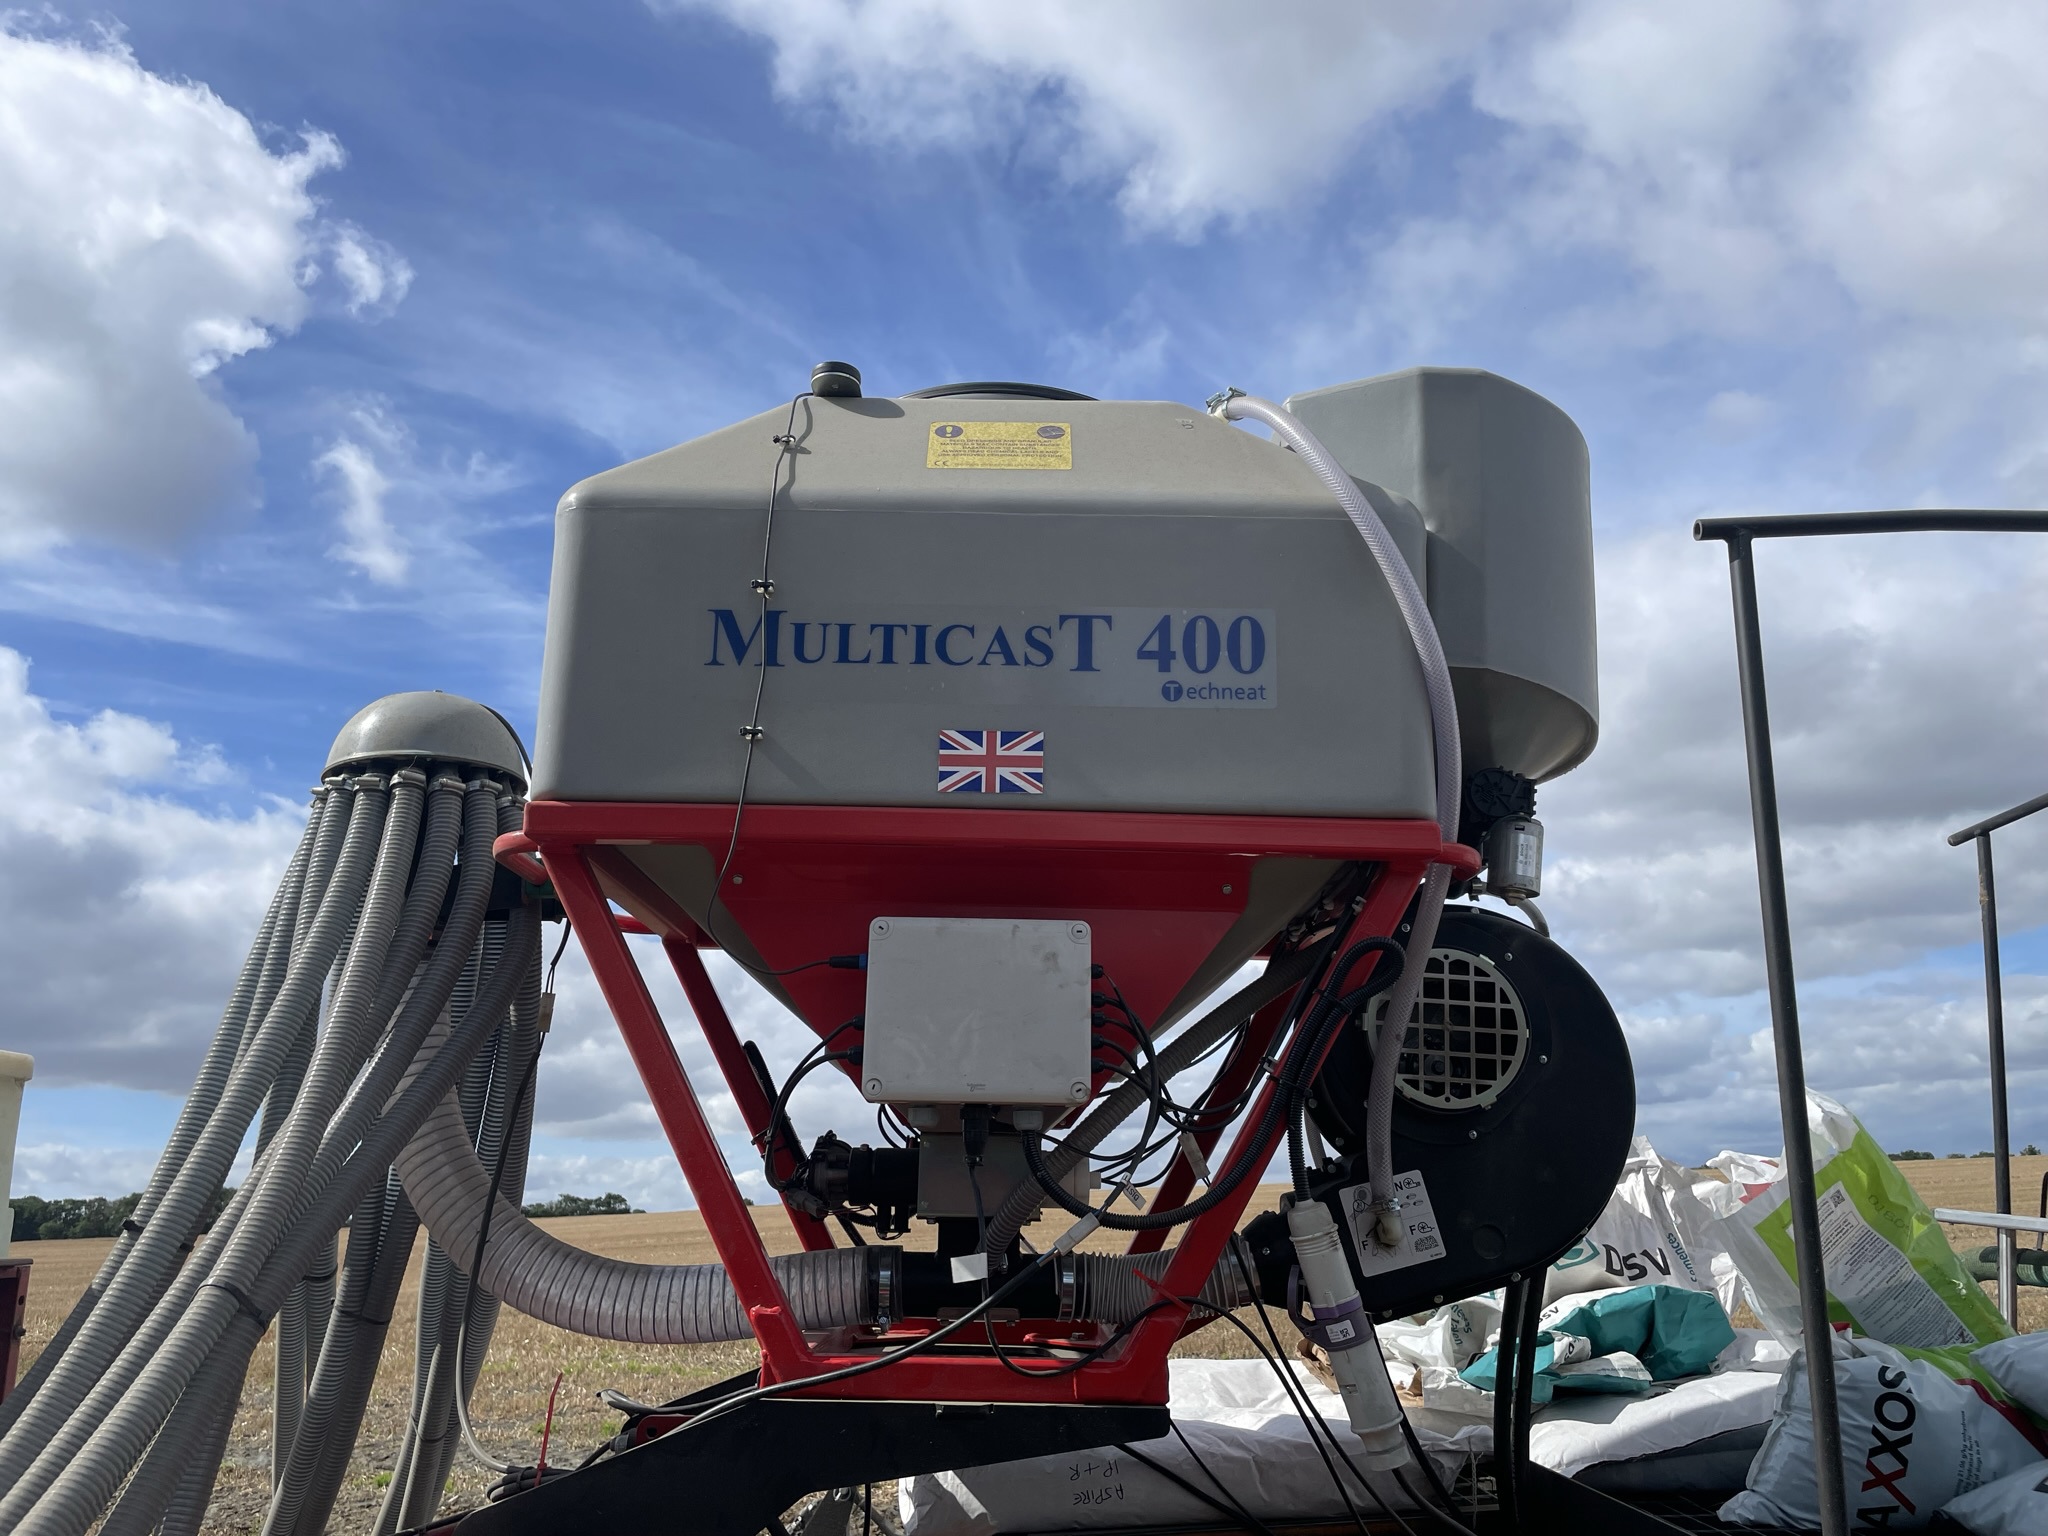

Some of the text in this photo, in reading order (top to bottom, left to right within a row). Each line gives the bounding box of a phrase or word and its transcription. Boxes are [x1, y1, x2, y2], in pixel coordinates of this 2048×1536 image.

[1136, 614, 1266, 675] 400
[1161, 680, 1267, 702] Techneat
[1394, 1181, 1403, 1192] N
[1408, 1224, 1417, 1236] F
[1361, 1239, 1369, 1250] F
[1602, 1243, 1672, 1282] DSV
[1072, 1483, 1125, 1506] ASPIRE
